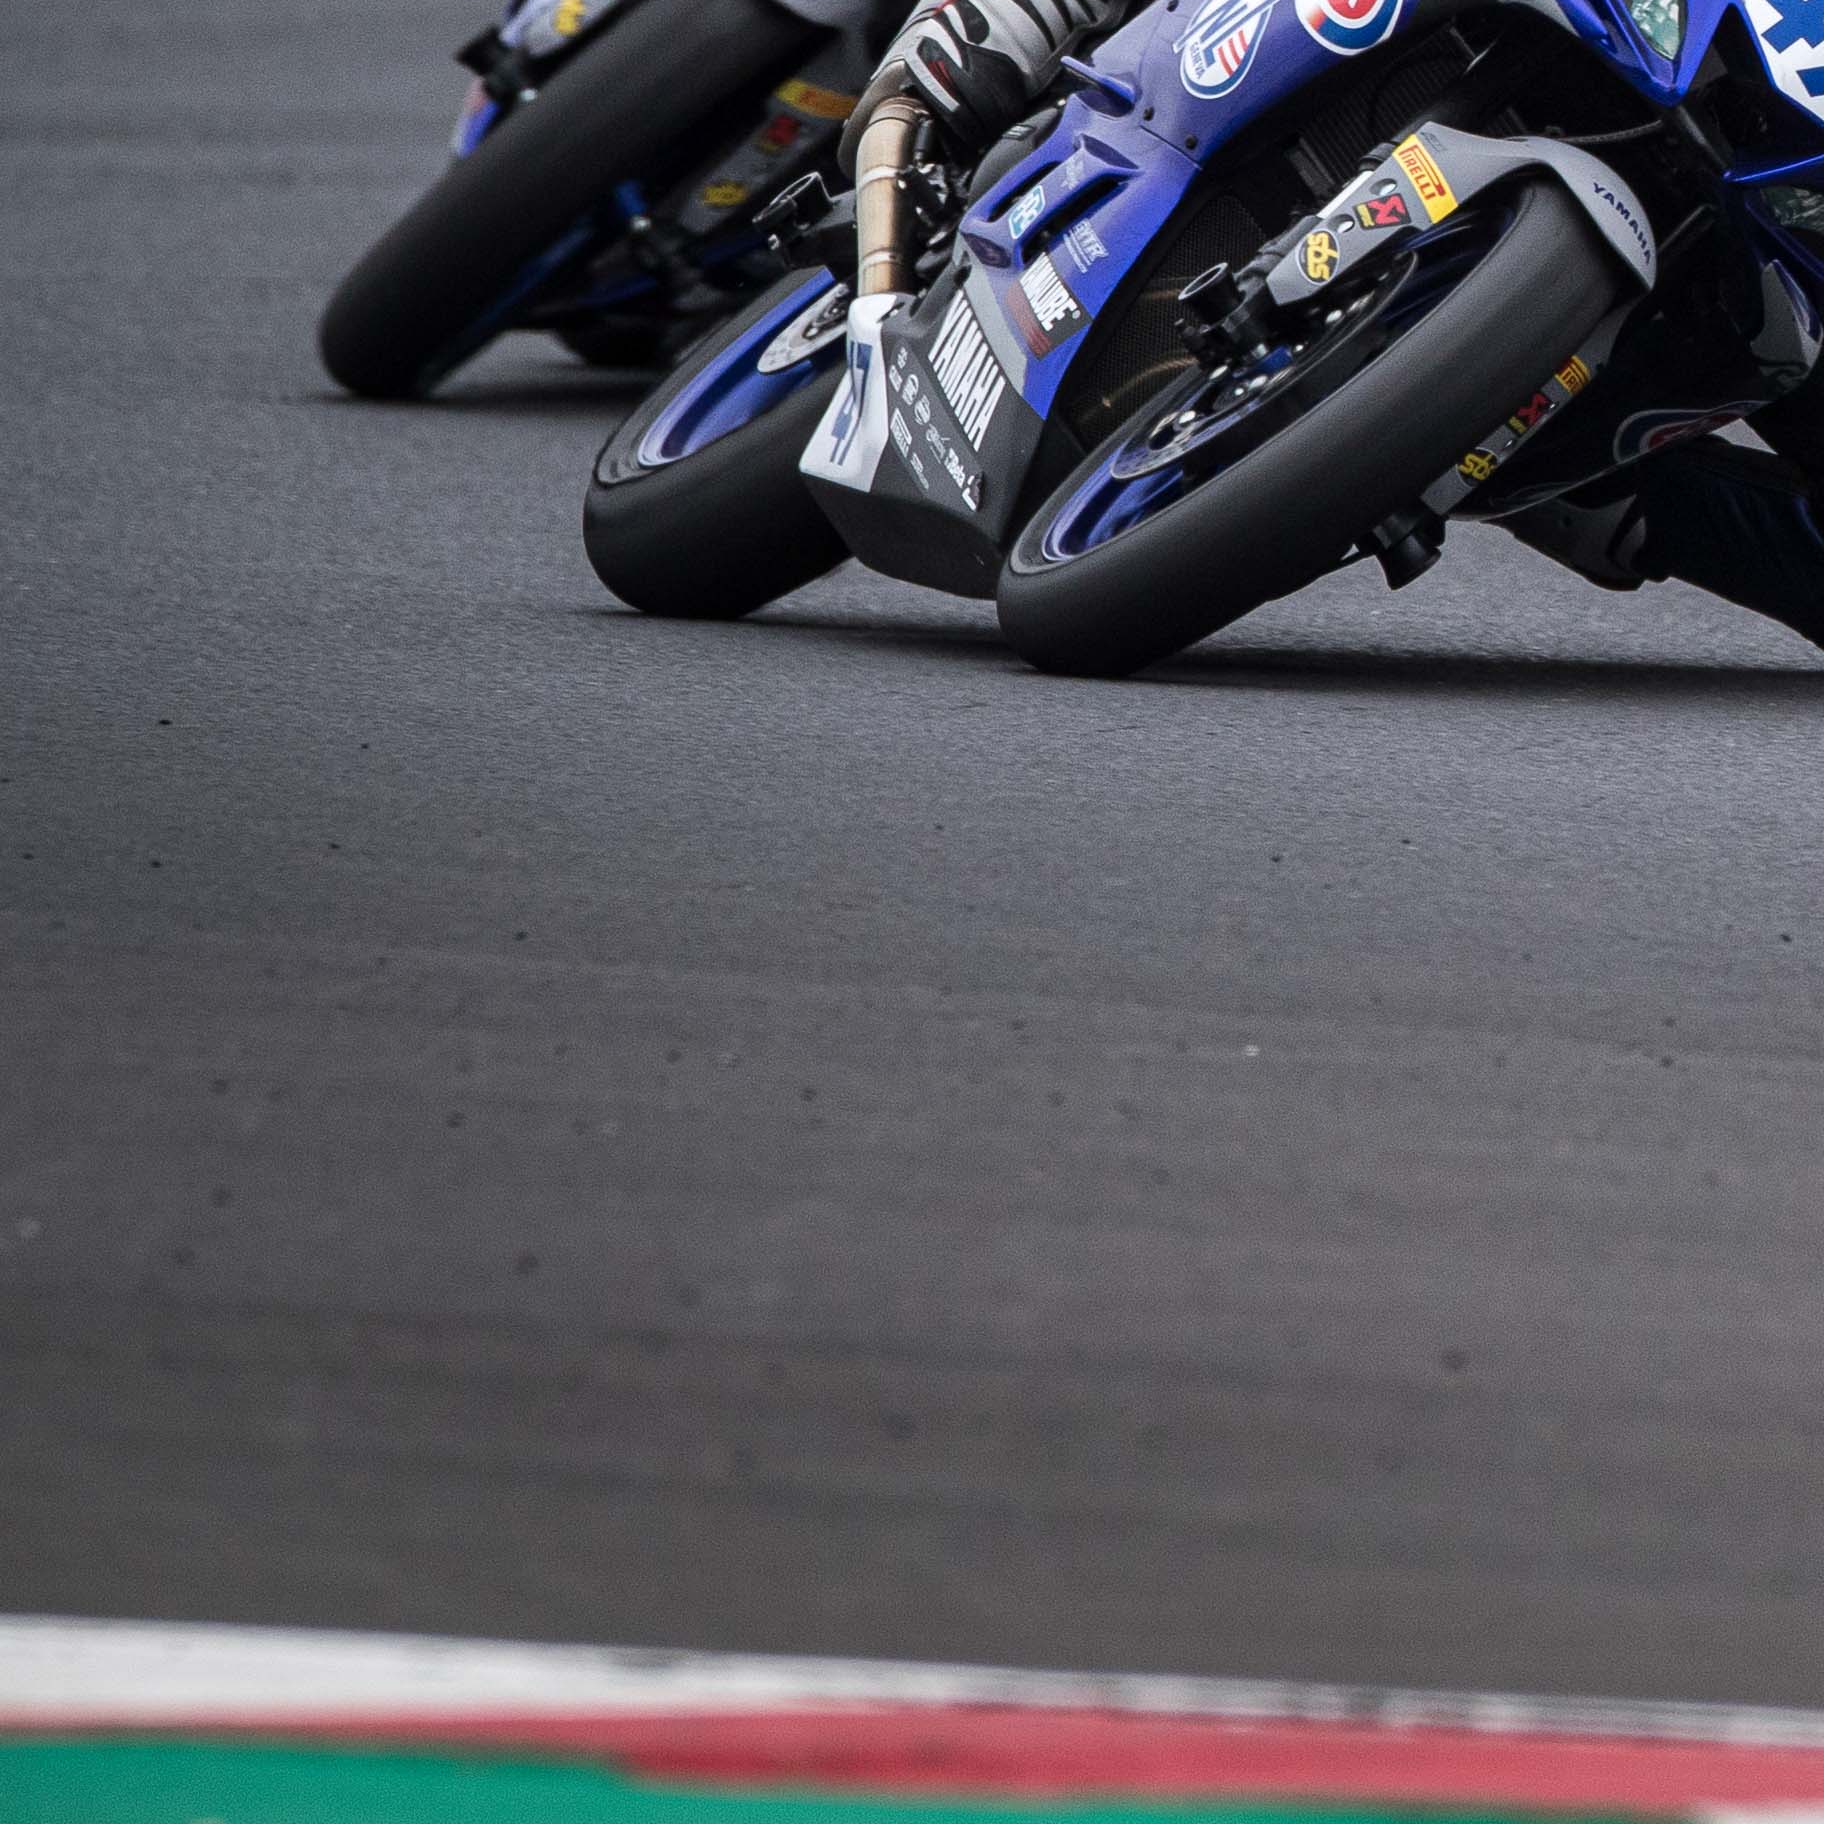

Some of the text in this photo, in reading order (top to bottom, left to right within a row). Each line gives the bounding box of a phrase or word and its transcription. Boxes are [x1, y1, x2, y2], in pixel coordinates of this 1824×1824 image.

[1397, 143, 1447, 201] PIRELLI
[1304, 231, 1338, 282] sbs
[1591, 182, 1652, 265] YAMAHA
[928, 288, 1006, 454] YAMAHA
